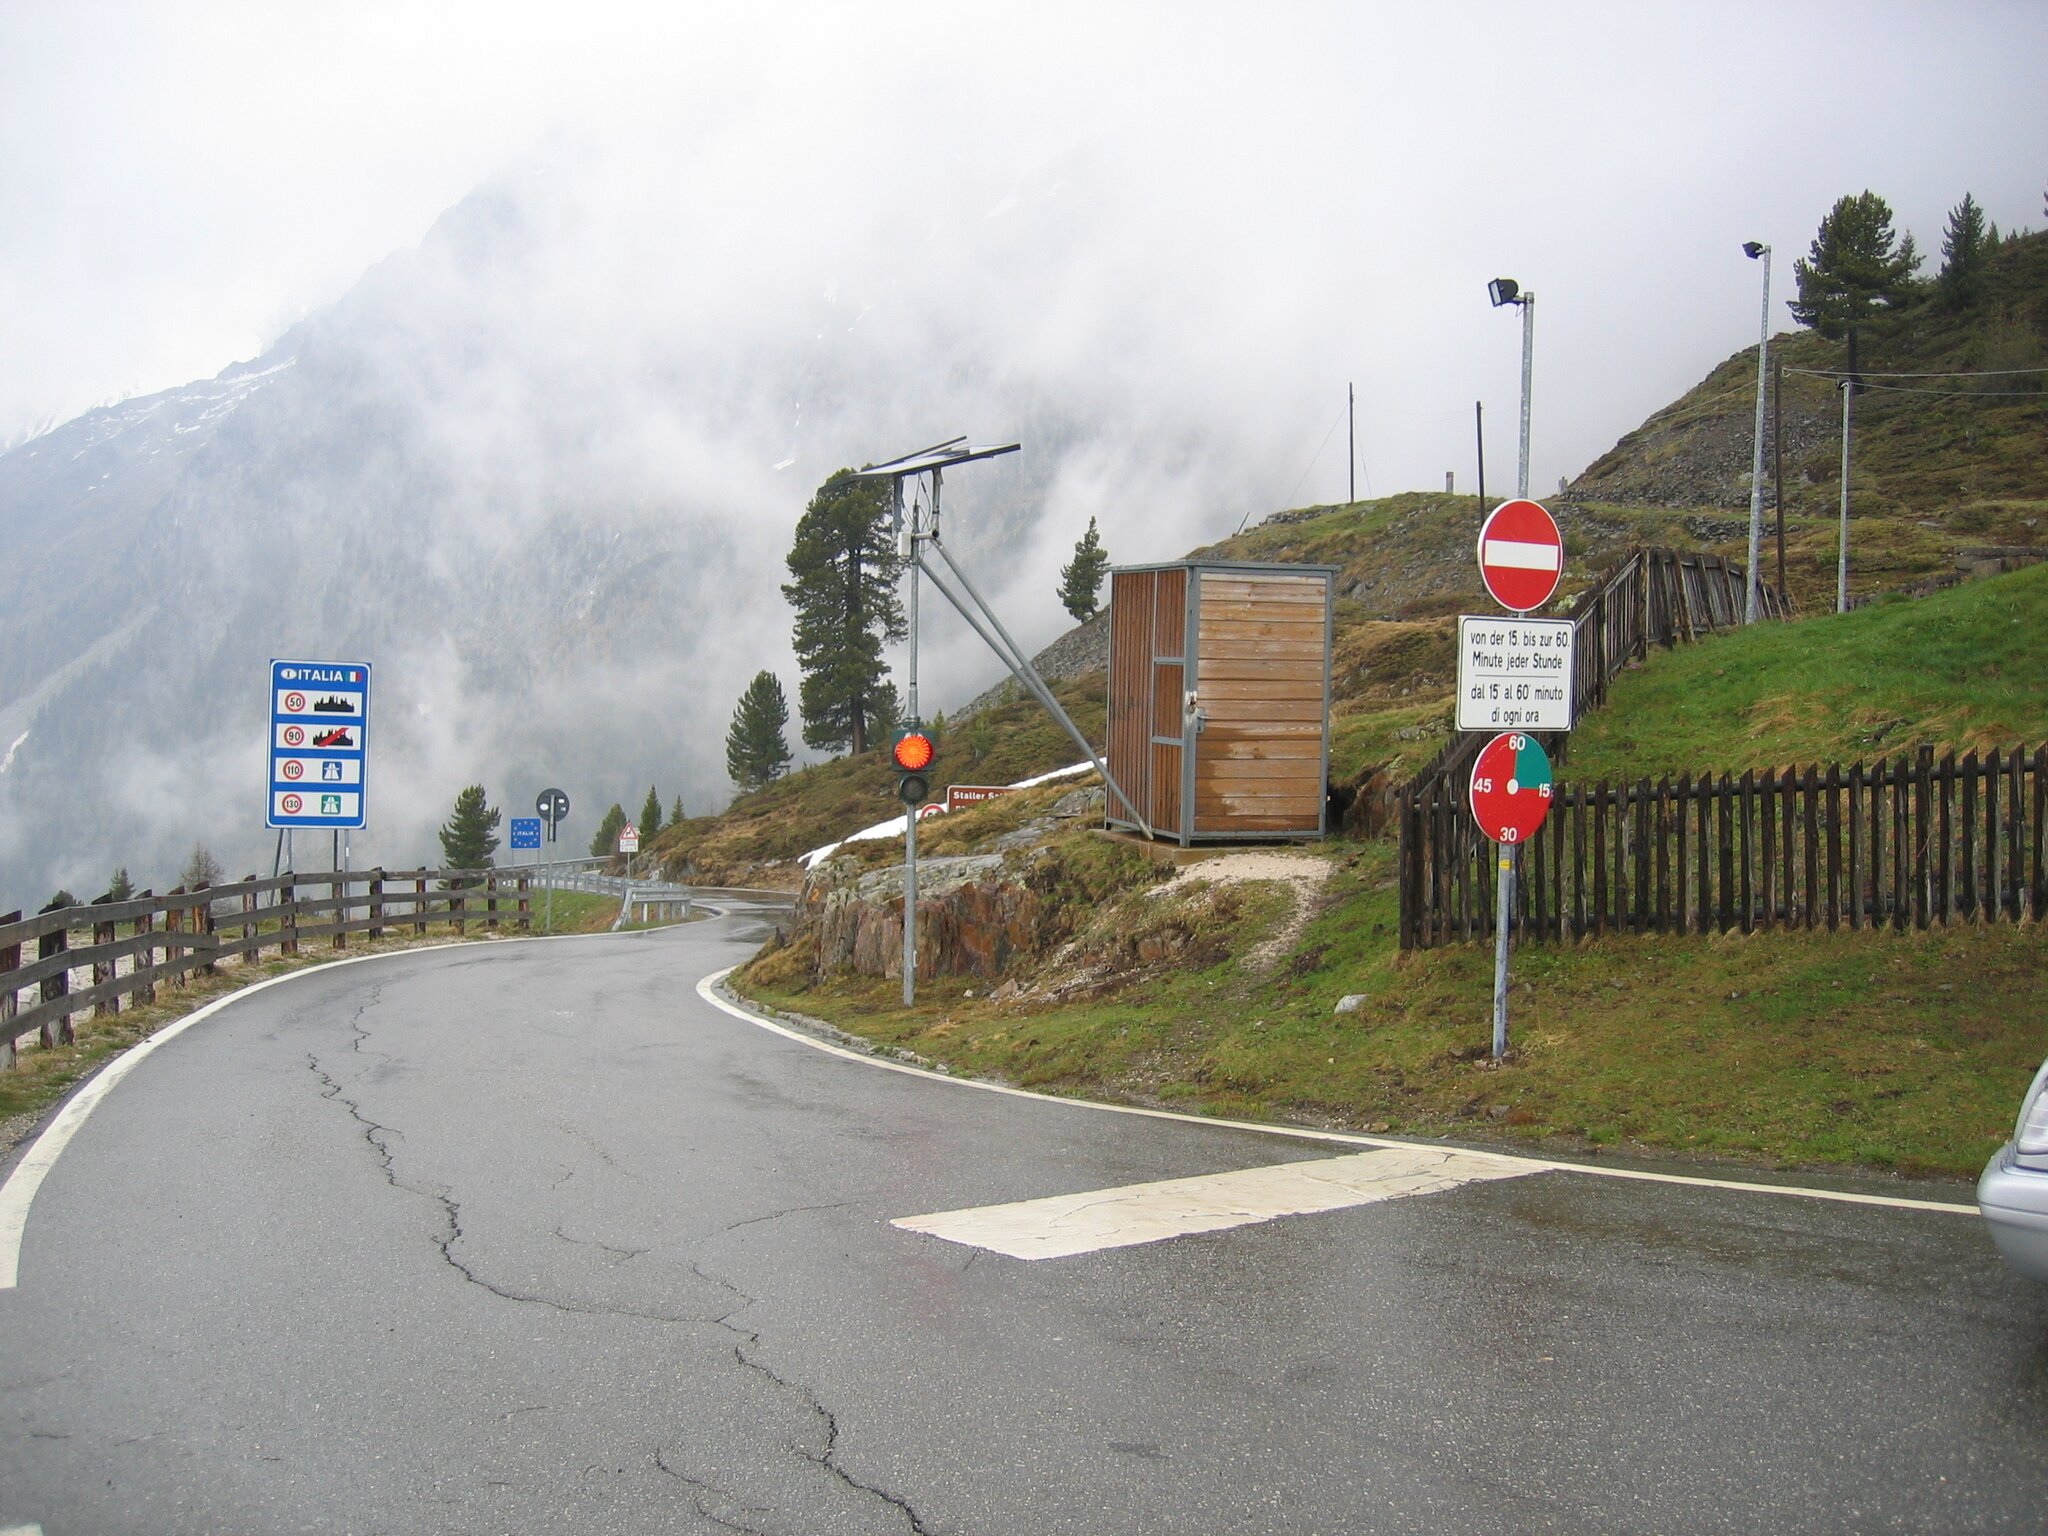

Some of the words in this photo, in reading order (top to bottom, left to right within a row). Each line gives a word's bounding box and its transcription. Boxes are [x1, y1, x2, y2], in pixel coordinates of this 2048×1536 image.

[1471, 632, 1486, 645] von
[1490, 630, 1504, 645] der
[1524, 631, 1536, 646] bis
[1540, 634, 1552, 647] zur
[1472, 651, 1503, 668] Minute
[1506, 653, 1529, 671] jeder
[1533, 653, 1562, 668] Stunde
[298, 669, 344, 681] ITALIA
[1471, 684, 1485, 699] dal
[1504, 685, 1512, 700] al
[1535, 686, 1563, 700] minuto
[289, 697, 301, 707] 50
[1491, 708, 1500, 722] di
[1503, 708, 1522, 725] ogni
[1526, 711, 1539, 722] ora
[289, 732, 300, 741] 90
[1509, 735, 1526, 751] 60
[287, 766, 300, 775] 110
[1474, 778, 1492, 793] 45
[1539, 783, 1550, 798] 15
[286, 800, 299, 808] 130
[1500, 827, 1517, 842] 30
